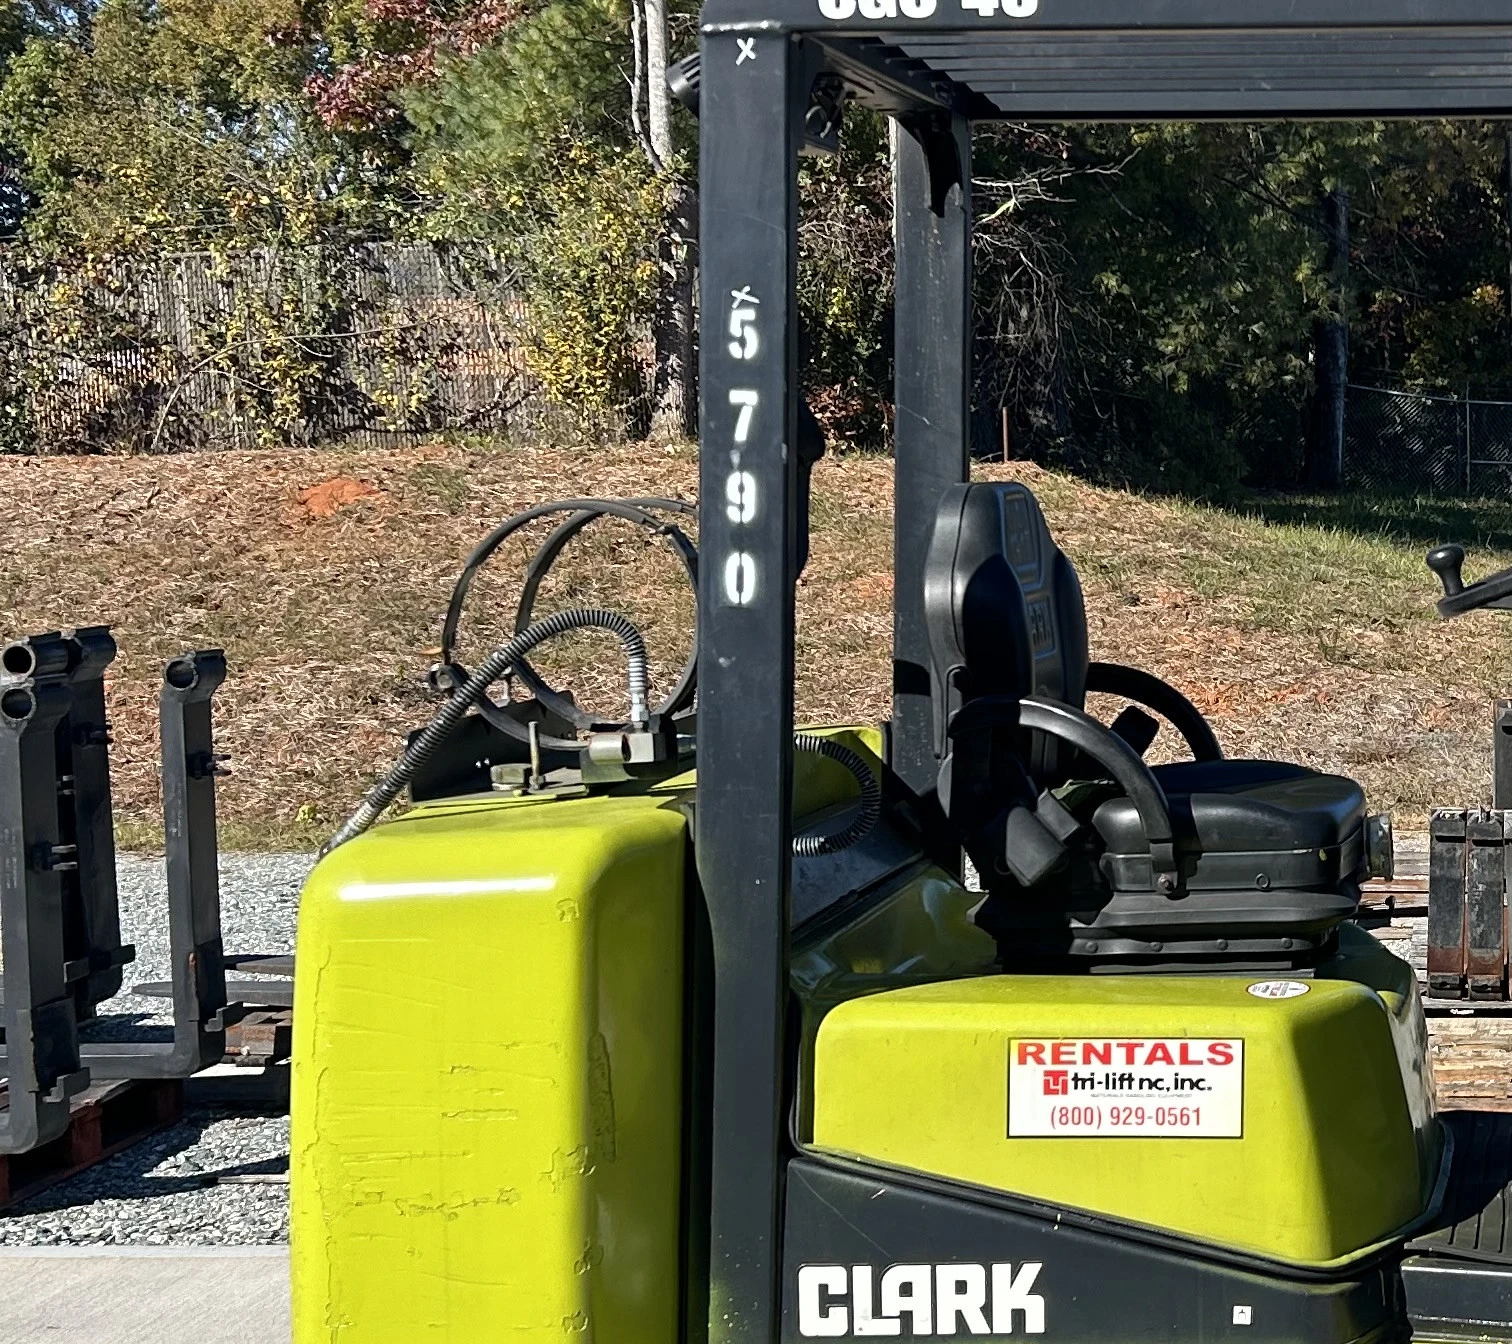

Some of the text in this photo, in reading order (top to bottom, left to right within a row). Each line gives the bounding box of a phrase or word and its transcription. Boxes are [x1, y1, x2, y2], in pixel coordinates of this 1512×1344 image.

[1017, 1042, 1235, 1066] RENTALS
[1071, 1072, 1135, 1091] tri-lift
[1050, 1106, 1201, 1130] (800) 929-0561
[798, 1261, 1045, 1337] CLARK
